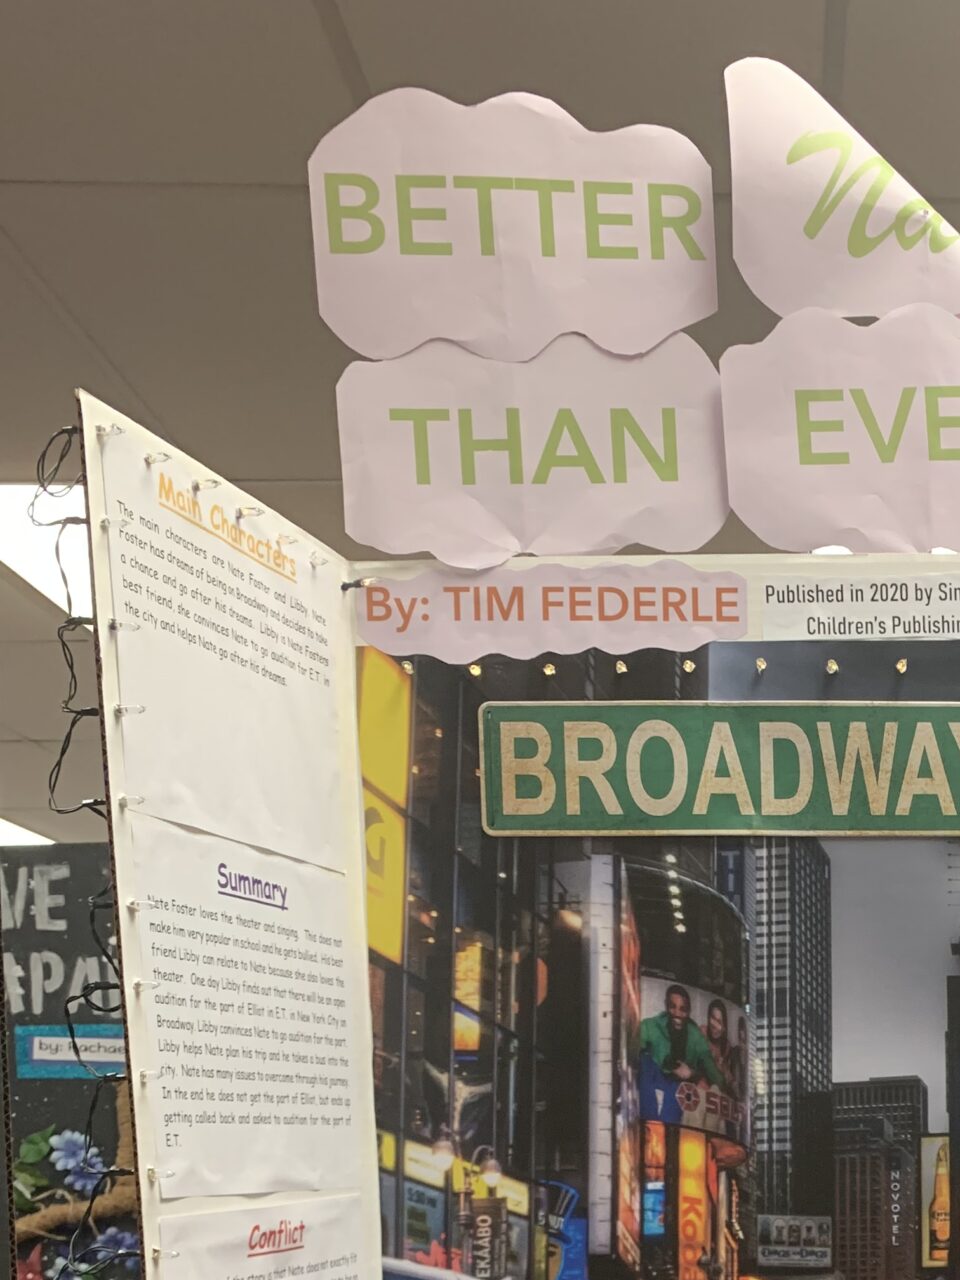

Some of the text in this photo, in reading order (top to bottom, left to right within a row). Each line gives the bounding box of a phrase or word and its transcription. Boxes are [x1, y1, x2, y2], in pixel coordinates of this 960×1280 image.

[322, 171, 708, 262] BETTER
[389, 406, 681, 487] THAN
[158, 471, 297, 577] Main Characters
[165, 528, 207, 559] characters
[167, 551, 194, 576] dreams
[364, 586, 741, 630] By: TIM FEDERLE
[765, 583, 844, 604] Published
[850, 583, 864, 603] in
[870, 583, 909, 603] 2020
[914, 582, 933, 604] by
[807, 616, 887, 636] Children's
[217, 863, 288, 910] Summary
[890, 1171, 901, 1246] NOVOTEL
[249, 1220, 305, 1250] Conflict
